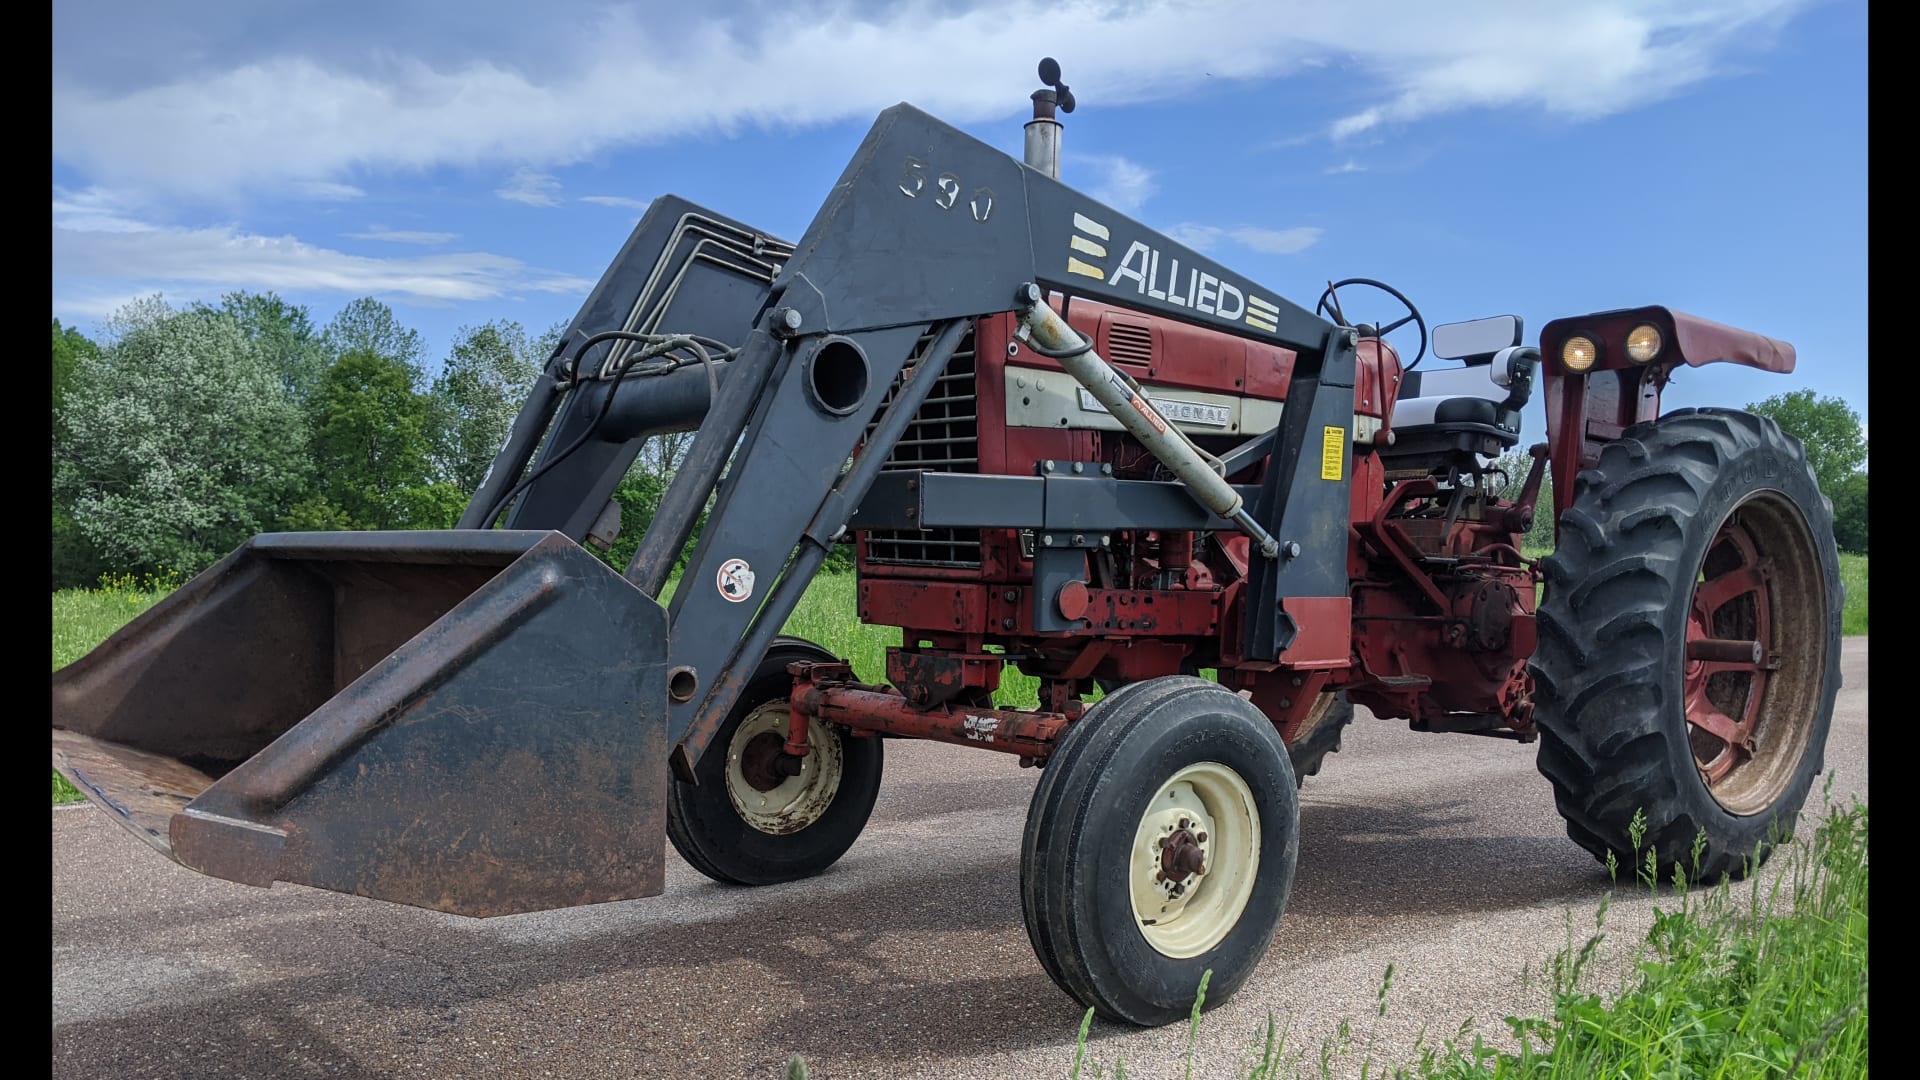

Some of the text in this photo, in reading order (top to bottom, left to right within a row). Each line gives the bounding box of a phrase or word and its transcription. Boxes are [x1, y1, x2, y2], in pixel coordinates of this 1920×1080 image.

[899, 157, 995, 222] 590
[1108, 240, 1245, 320] ALLIED
[1140, 407, 1165, 431] ALLIED
